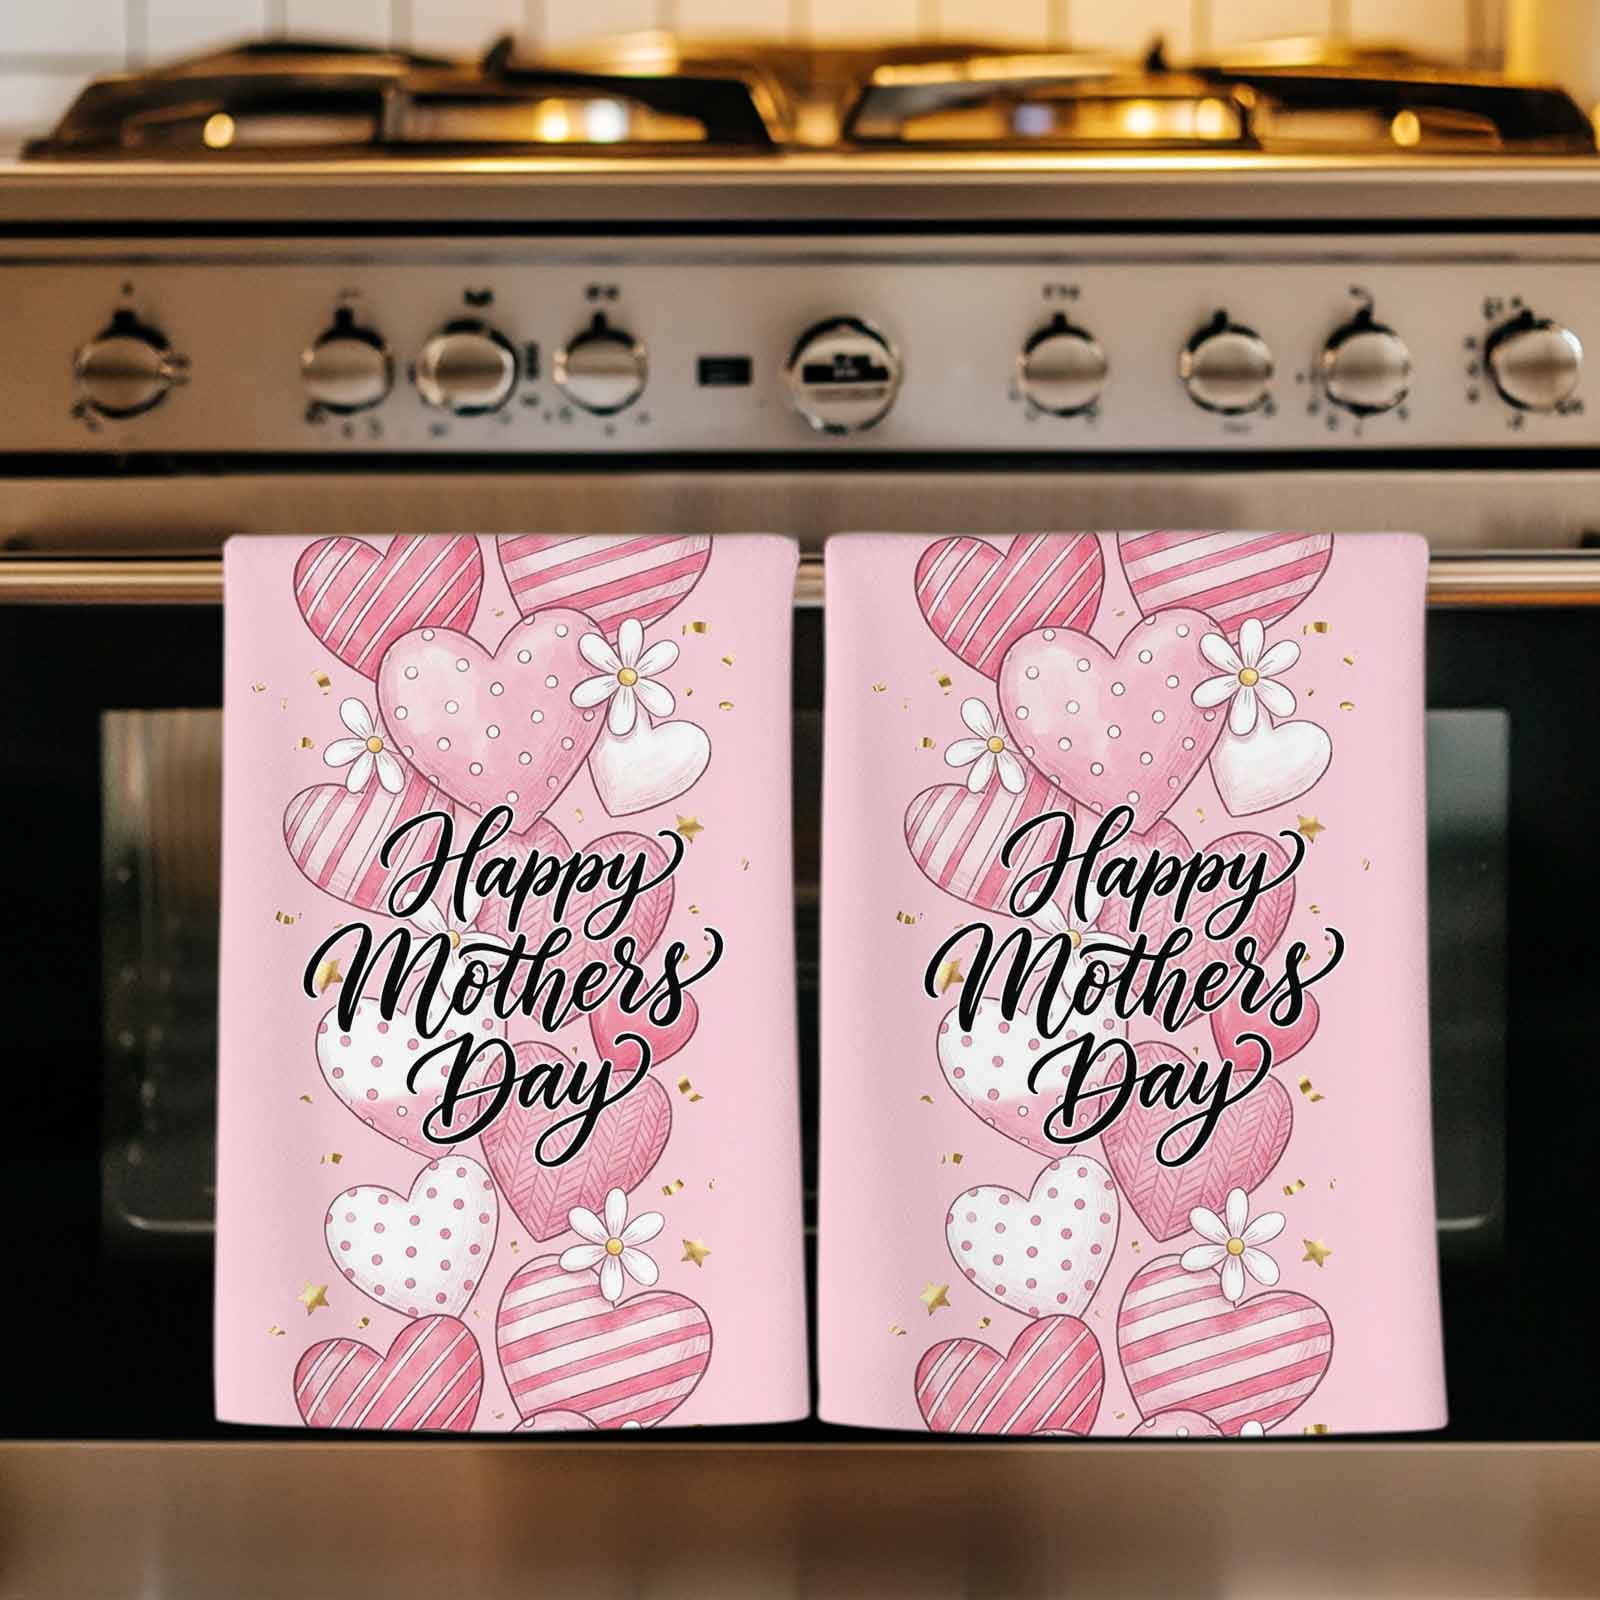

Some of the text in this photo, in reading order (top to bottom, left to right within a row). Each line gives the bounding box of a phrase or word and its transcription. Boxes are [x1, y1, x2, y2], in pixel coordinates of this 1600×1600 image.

[380, 805, 684, 941] Happy
[1001, 805, 1305, 941] Happy
[303, 922, 724, 1039] Mothers
[924, 922, 1345, 1039] Mothers
[406, 1032, 651, 1167] Day
[1027, 1032, 1272, 1167] Day
